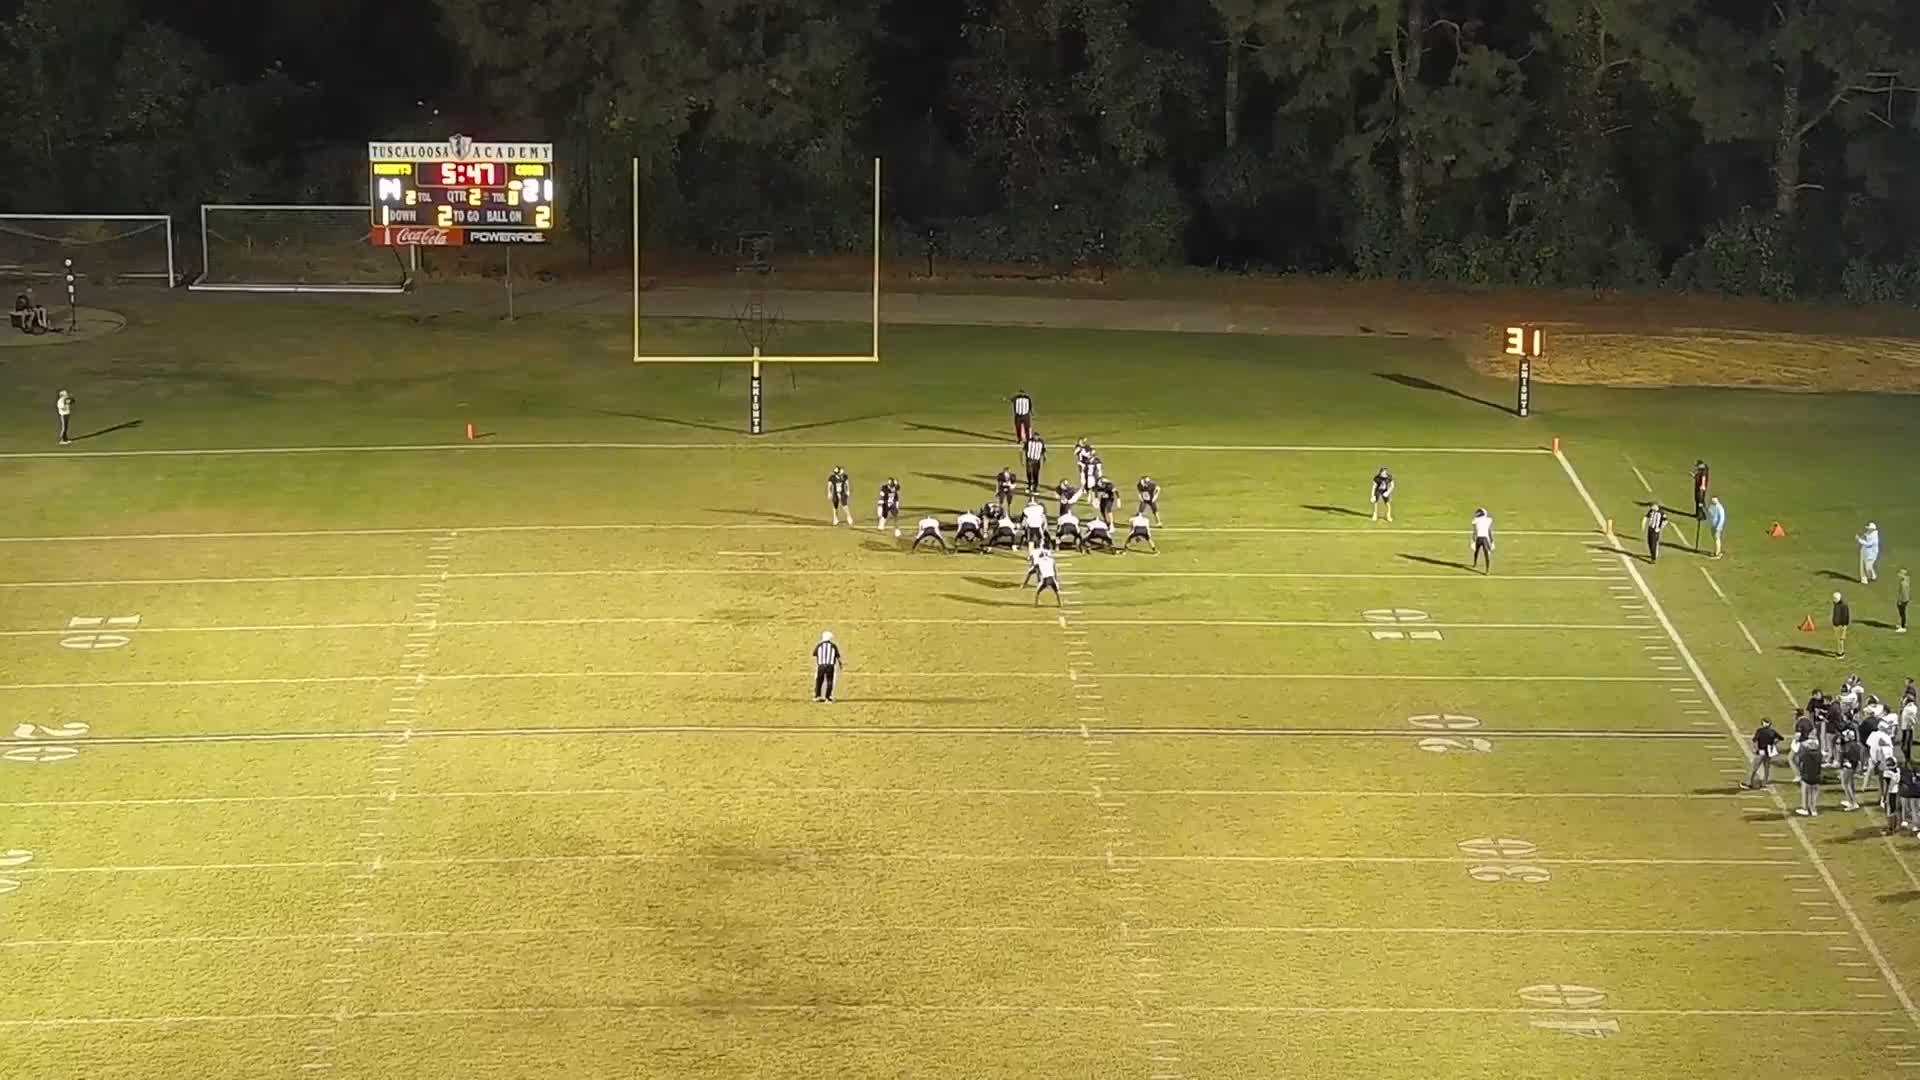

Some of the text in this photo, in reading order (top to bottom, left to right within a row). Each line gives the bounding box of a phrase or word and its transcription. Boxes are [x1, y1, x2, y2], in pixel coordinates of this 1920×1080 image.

[372, 146, 550, 158] TUSCALOOSA ACADEMY
[441, 163, 495, 185] 5:47
[405, 190, 417, 205] 2
[447, 191, 466, 203] QTR
[468, 188, 481, 206] 2
[389, 210, 417, 221] DOWN
[438, 205, 453, 227] 2
[454, 210, 480, 222] TO GO
[487, 210, 522, 222] BALL ON
[536, 206, 551, 228] 2
[470, 231, 546, 243] POWERADE
[1505, 327, 1541, 357] 31
[58, 614, 142, 649] 10
[1360, 608, 1445, 641] 10
[1, 721, 90, 762] 20
[1407, 713, 1493, 753] 20
[1456, 836, 1552, 883] 30
[1516, 984, 1621, 1038] 40
